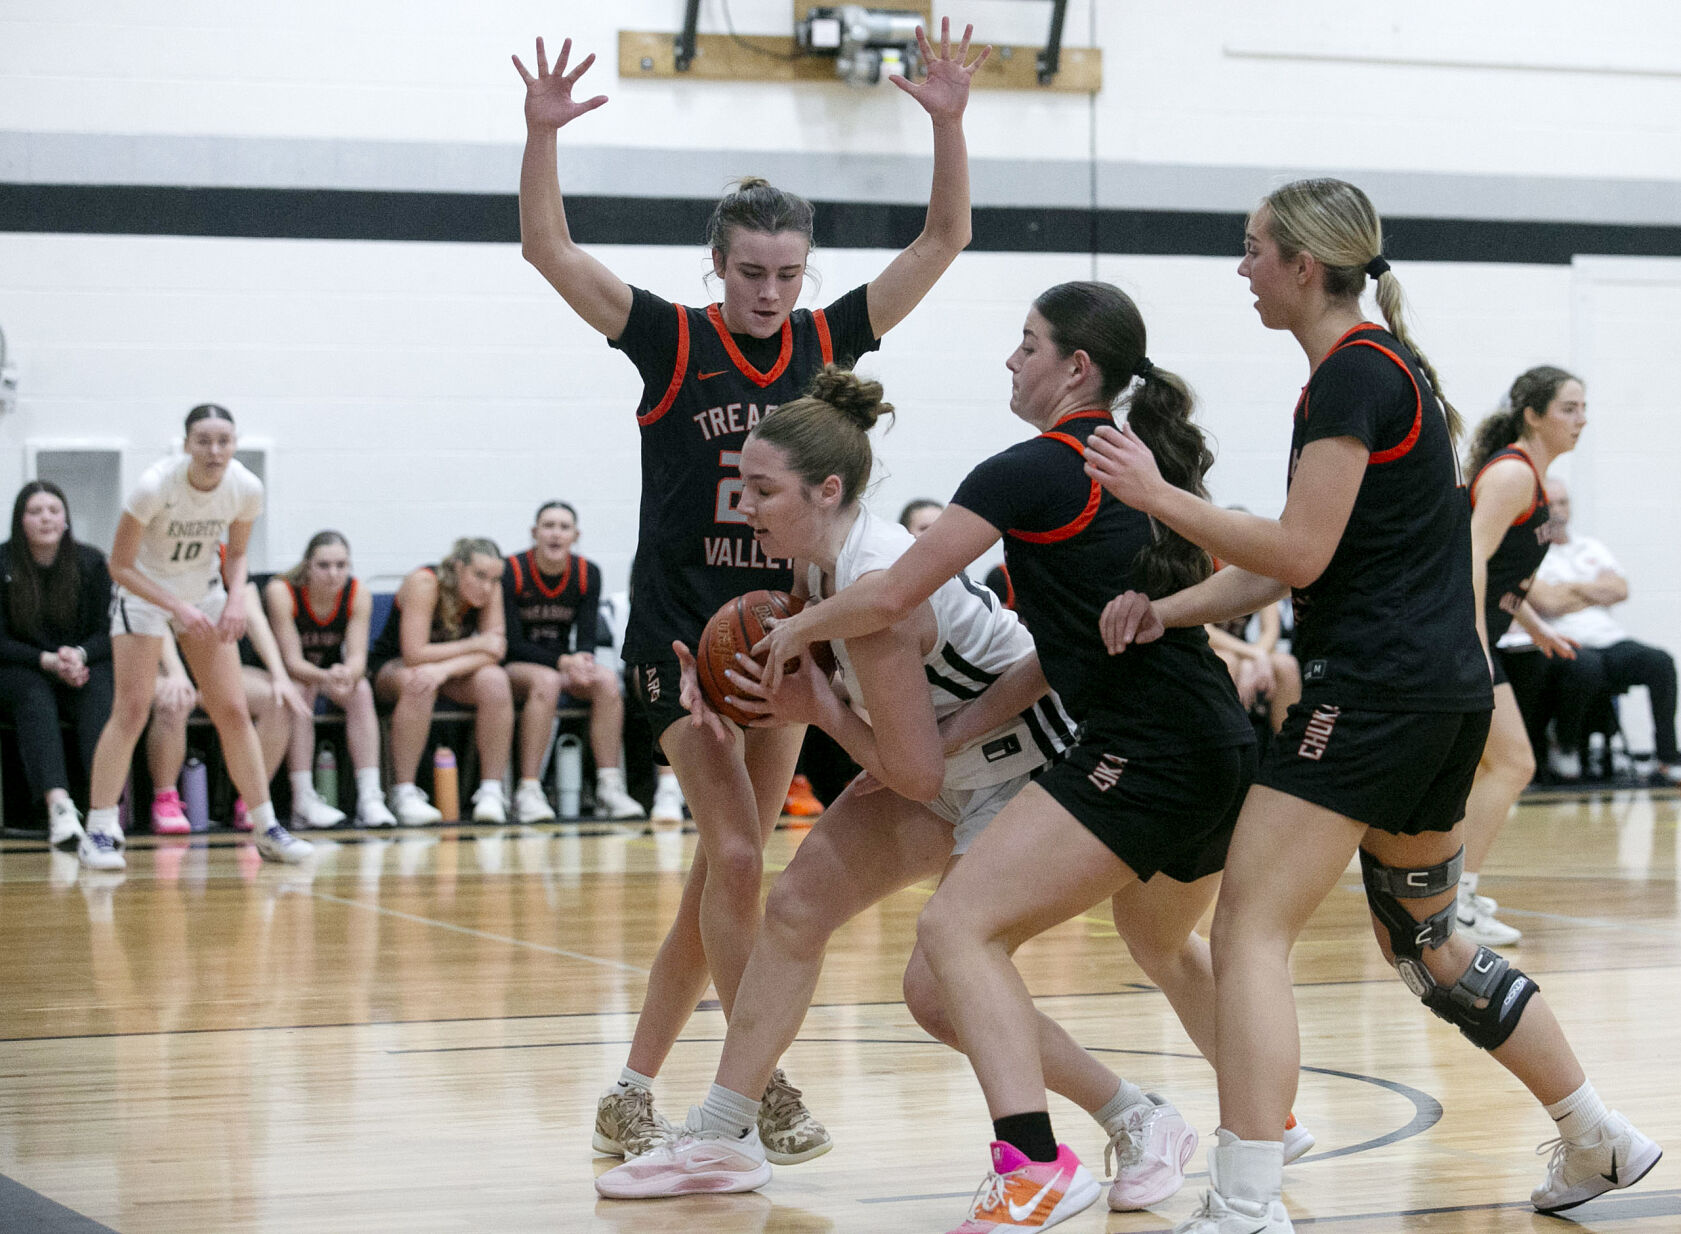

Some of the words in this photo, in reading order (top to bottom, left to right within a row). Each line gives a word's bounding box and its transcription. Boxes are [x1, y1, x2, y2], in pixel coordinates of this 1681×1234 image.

[693, 402, 779, 440] TREA
[171, 541, 203, 562] 10
[703, 536, 795, 570] VALL
[646, 664, 661, 703] ARS
